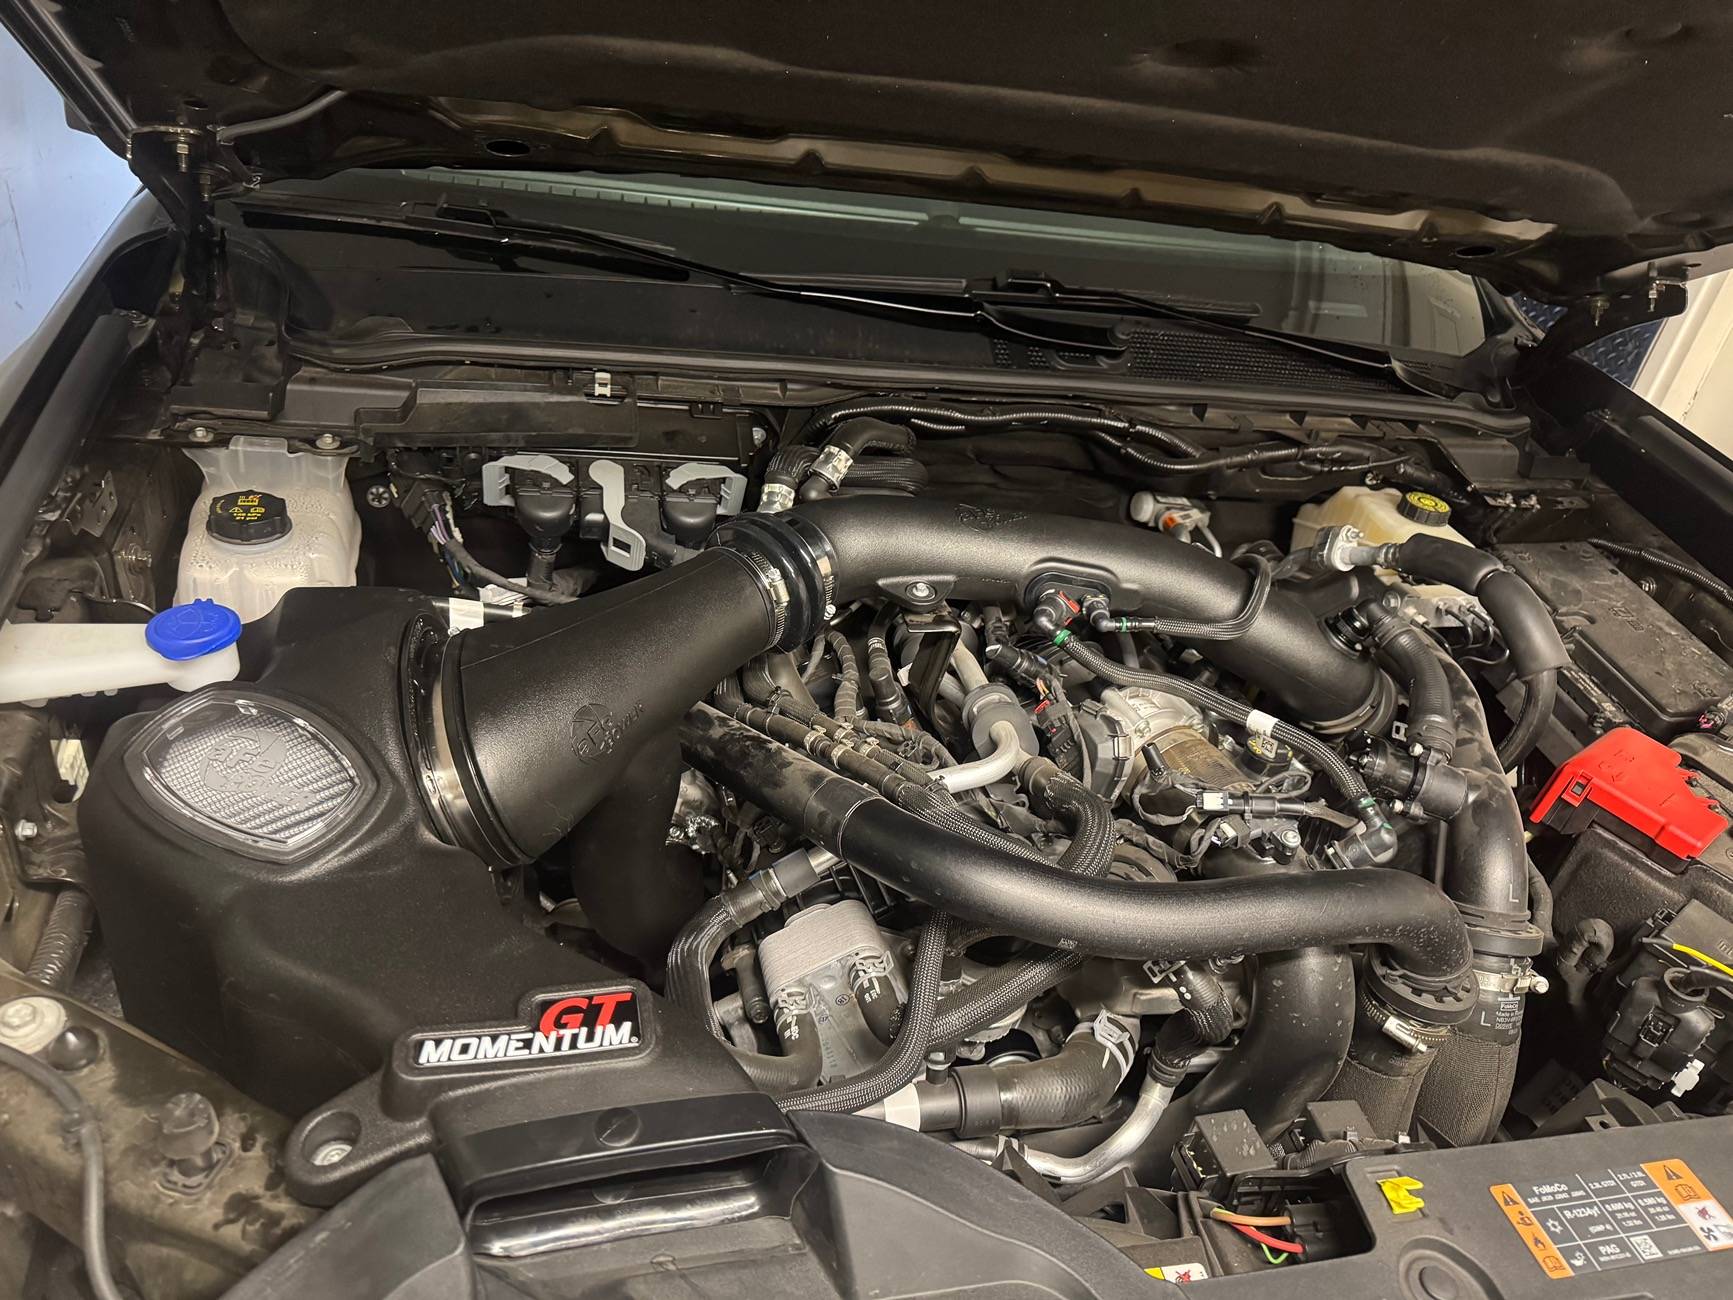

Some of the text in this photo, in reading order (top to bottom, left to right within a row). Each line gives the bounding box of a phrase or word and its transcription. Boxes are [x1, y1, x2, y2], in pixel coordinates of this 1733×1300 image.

[1509, 883, 1520, 903] L
[539, 992, 633, 1037] GT
[1480, 1010, 1491, 1027] L
[418, 1021, 634, 1064] MOMENTUM
[1532, 1183, 1569, 1195] FoMoCo
[1563, 1205, 1601, 1219] R-1234yf
[1598, 1243, 1620, 1256] PAG
